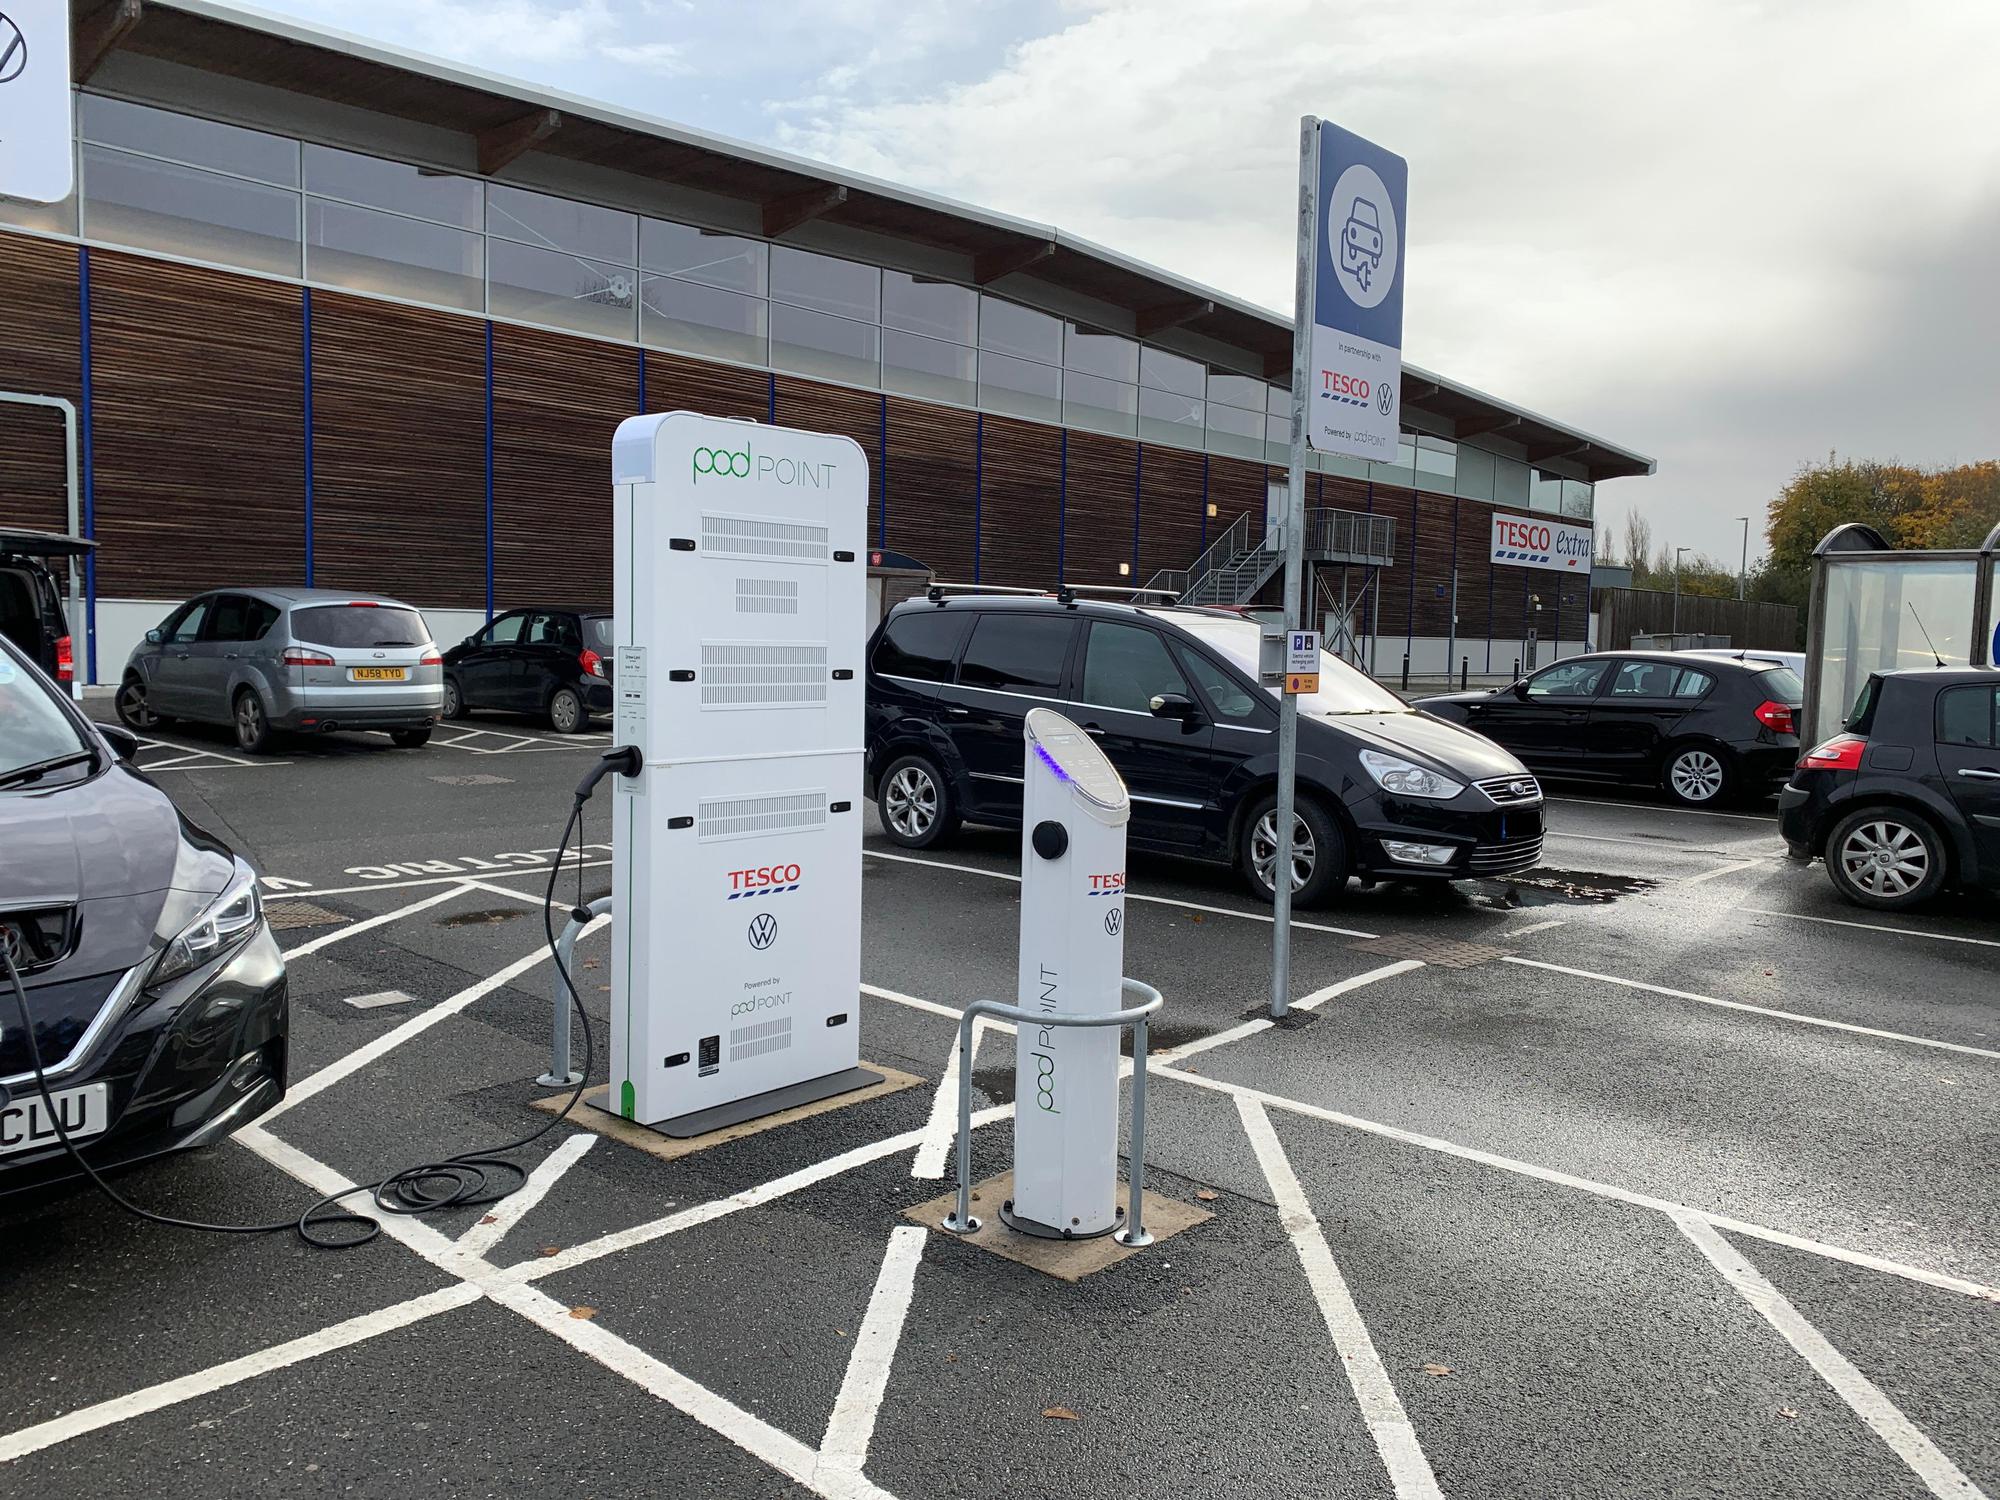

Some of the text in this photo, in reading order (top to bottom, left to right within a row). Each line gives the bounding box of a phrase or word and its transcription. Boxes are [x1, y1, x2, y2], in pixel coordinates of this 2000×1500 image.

[1322, 370, 1369, 398] TESCO
[1324, 425, 1345, 438] Powered
[693, 441, 836, 489] pod POINT
[1495, 520, 1590, 558] TESCO extra
[357, 669, 402, 678] NJ58 TYD
[343, 843, 613, 880] LECTRIC
[728, 864, 801, 890] TESCO
[744, 976, 781, 990] Powered by
[731, 991, 793, 1020] pod POINT
[1030, 1052, 1061, 1114] pod
